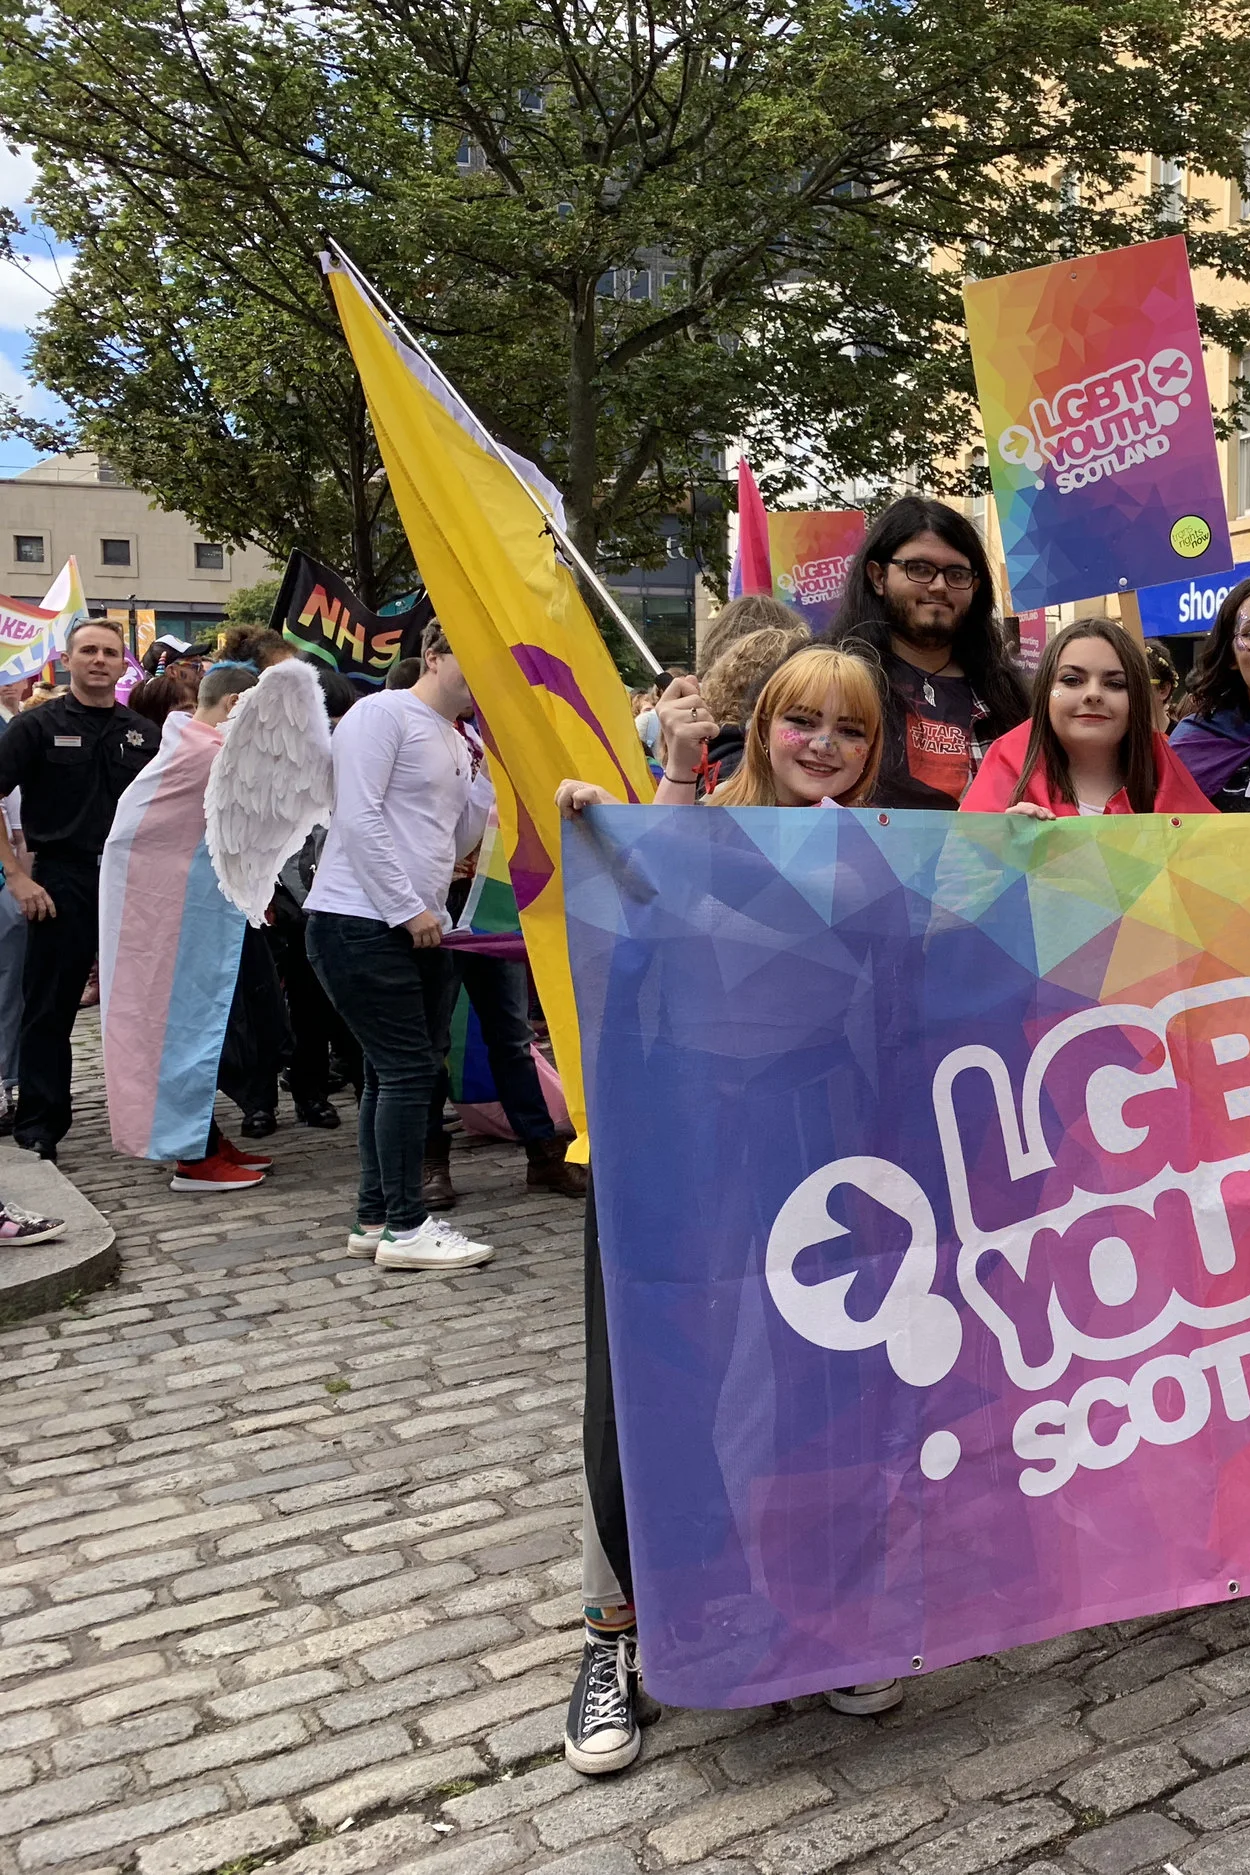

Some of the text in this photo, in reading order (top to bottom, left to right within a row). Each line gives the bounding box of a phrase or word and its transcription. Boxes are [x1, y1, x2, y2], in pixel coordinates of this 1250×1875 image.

[1029, 359, 1146, 440] LGBT
[1040, 396, 1161, 472] YOUTH
[1056, 434, 1170, 494] SCOTLAND
[1172, 525, 1194, 542] trans
[1179, 529, 1204, 548] rights
[1191, 533, 1210, 549] now
[793, 556, 843, 581] LGBT
[1178, 582, 1236, 623] shoe
[298, 583, 403, 669] NHS
[911, 721, 965, 741] STAR
[912, 735, 966, 755] WARS
